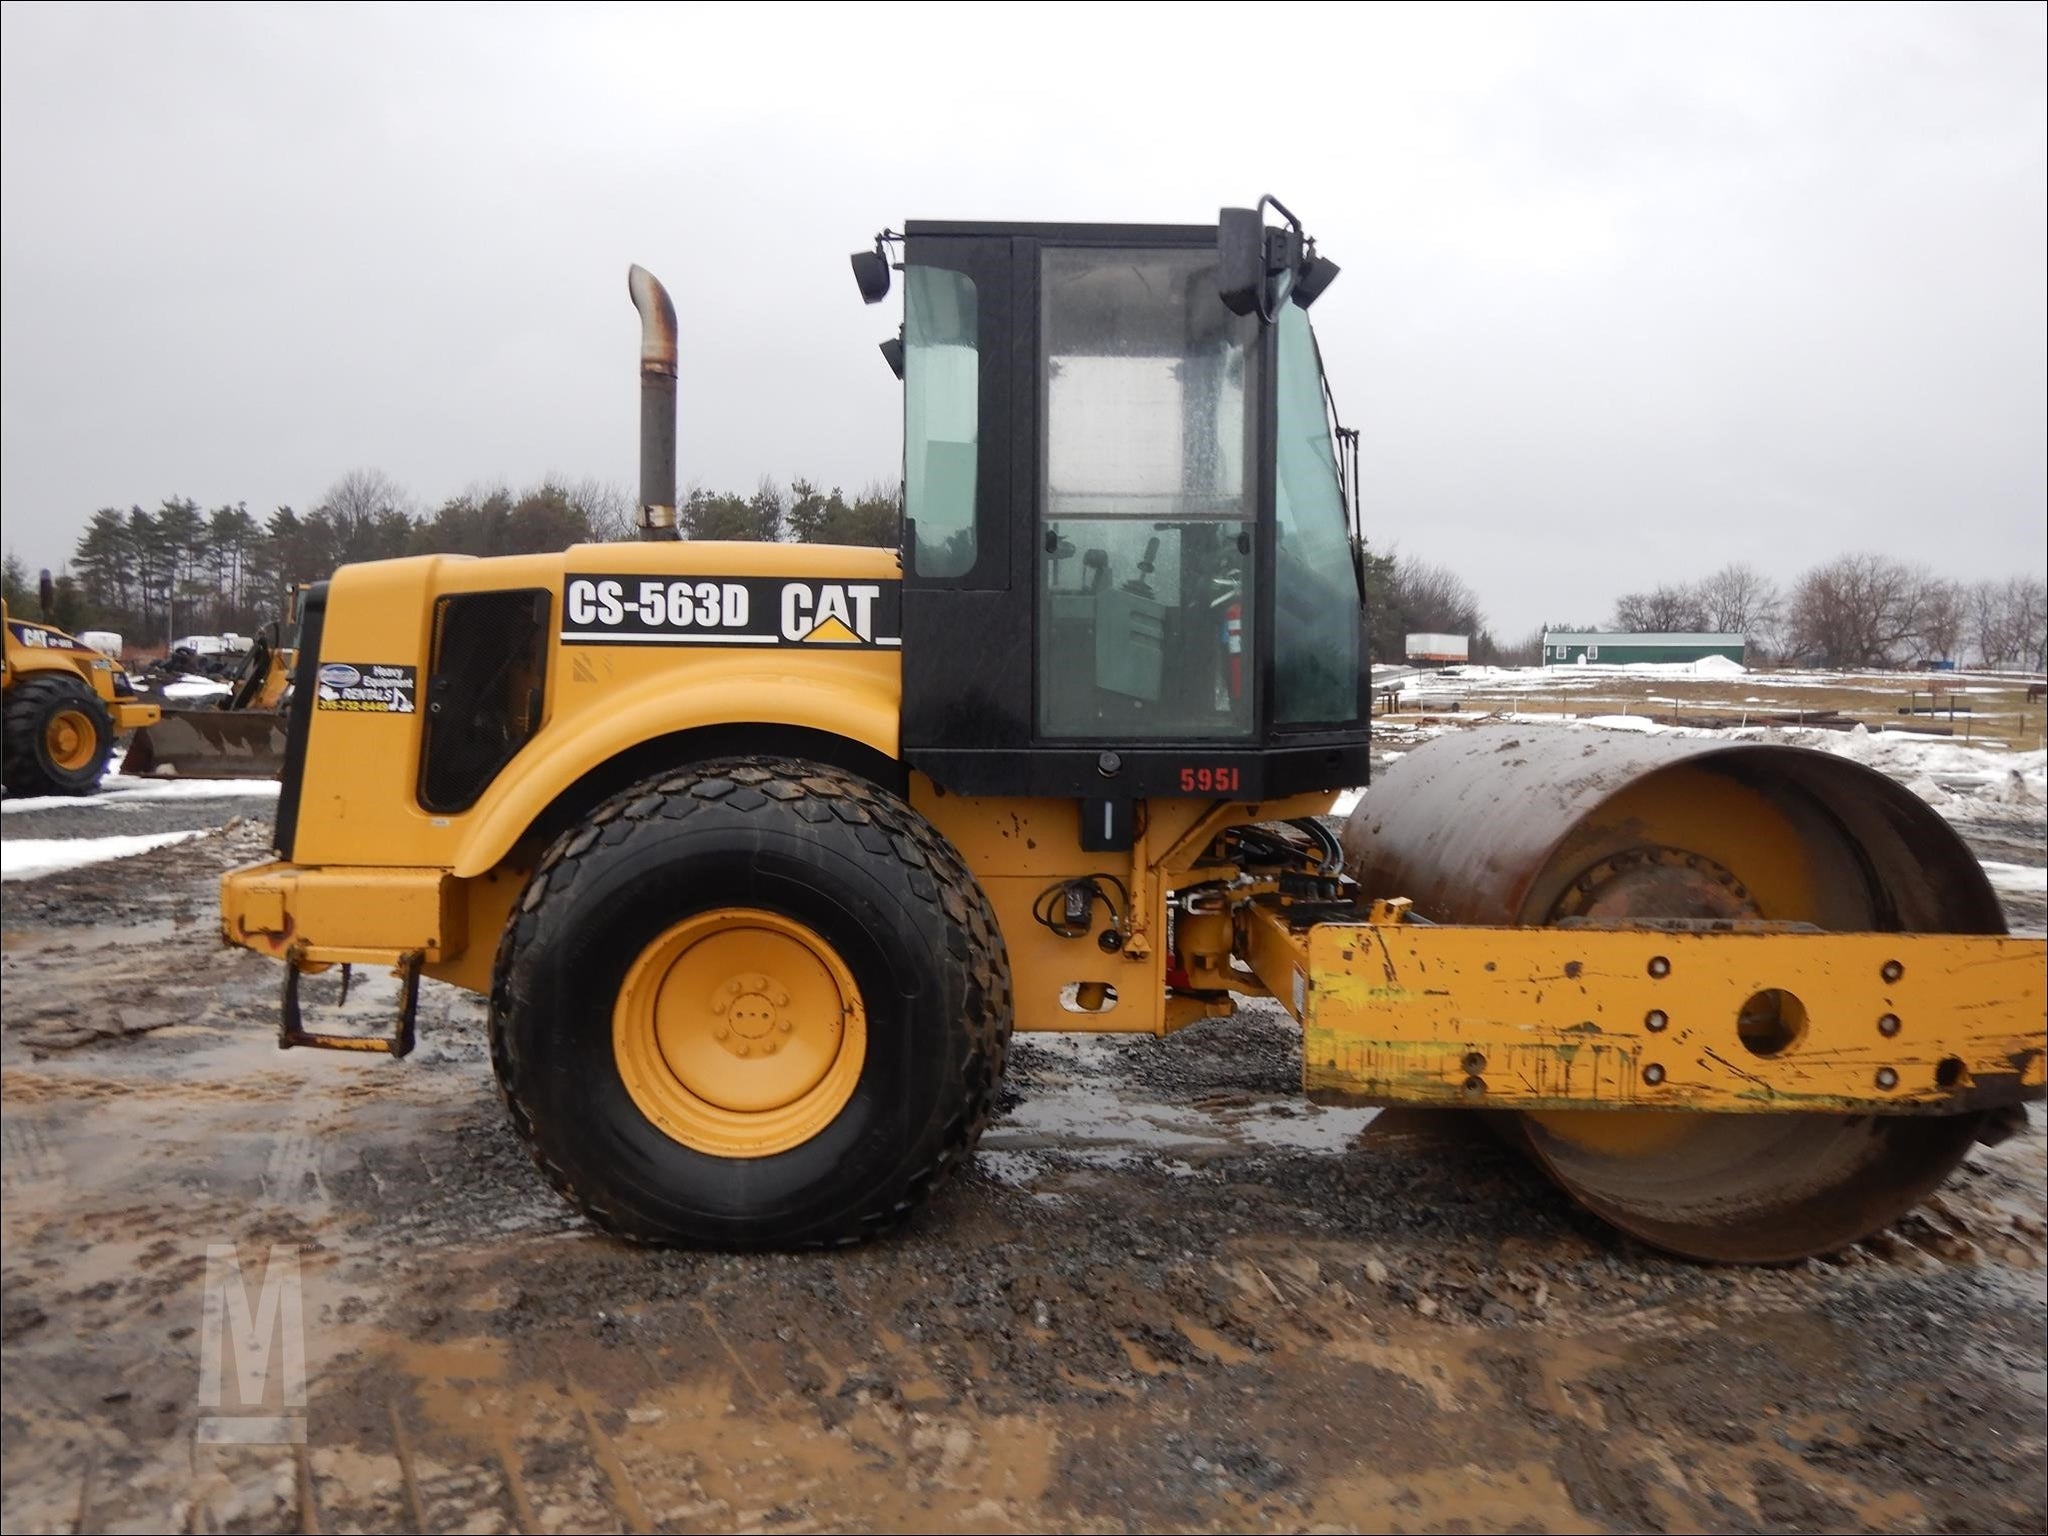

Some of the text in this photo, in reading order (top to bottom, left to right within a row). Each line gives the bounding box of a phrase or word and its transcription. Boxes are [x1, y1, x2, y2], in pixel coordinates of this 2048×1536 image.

[568, 579, 880, 643] CS-563D CAT
[24, 628, 48, 648] CAT
[373, 665, 403, 680] Heavy
[363, 675, 413, 688] Equipment
[342, 687, 393, 701] RENTALS
[1180, 767, 1240, 792] 5951
